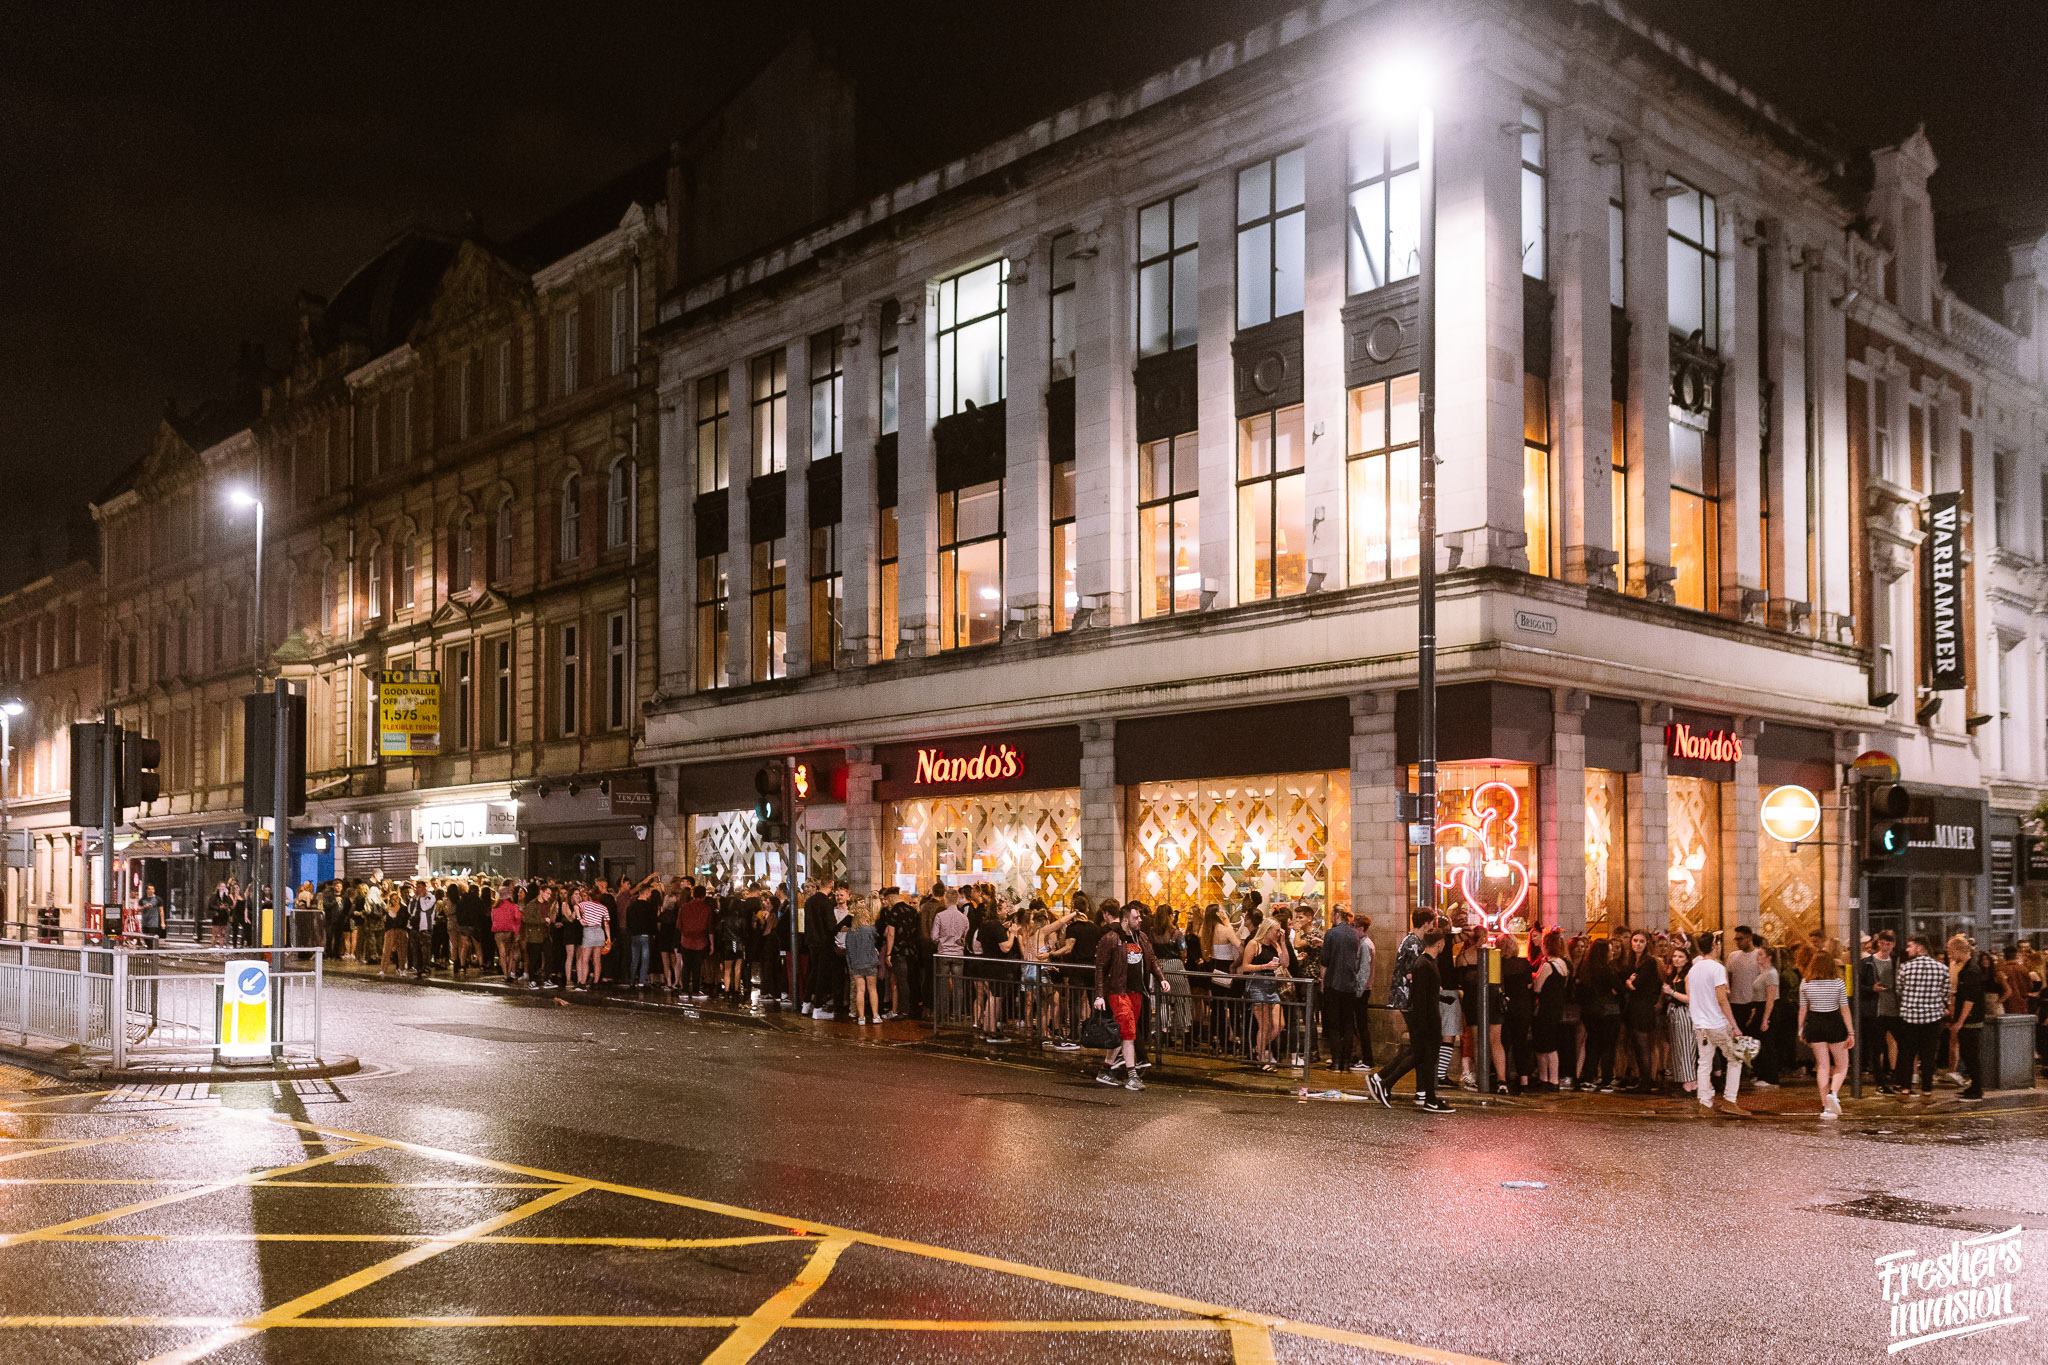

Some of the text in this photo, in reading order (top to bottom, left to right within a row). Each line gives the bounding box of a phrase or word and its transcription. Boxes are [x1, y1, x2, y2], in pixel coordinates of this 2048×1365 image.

[1933, 505, 1957, 674] WARHAMMER
[383, 670, 438, 683] TO LET
[384, 688, 436, 696] GOOD VALUE
[383, 709, 417, 721] 1,575
[1673, 723, 1743, 762] Nando's
[914, 744, 1016, 784] Nando's
